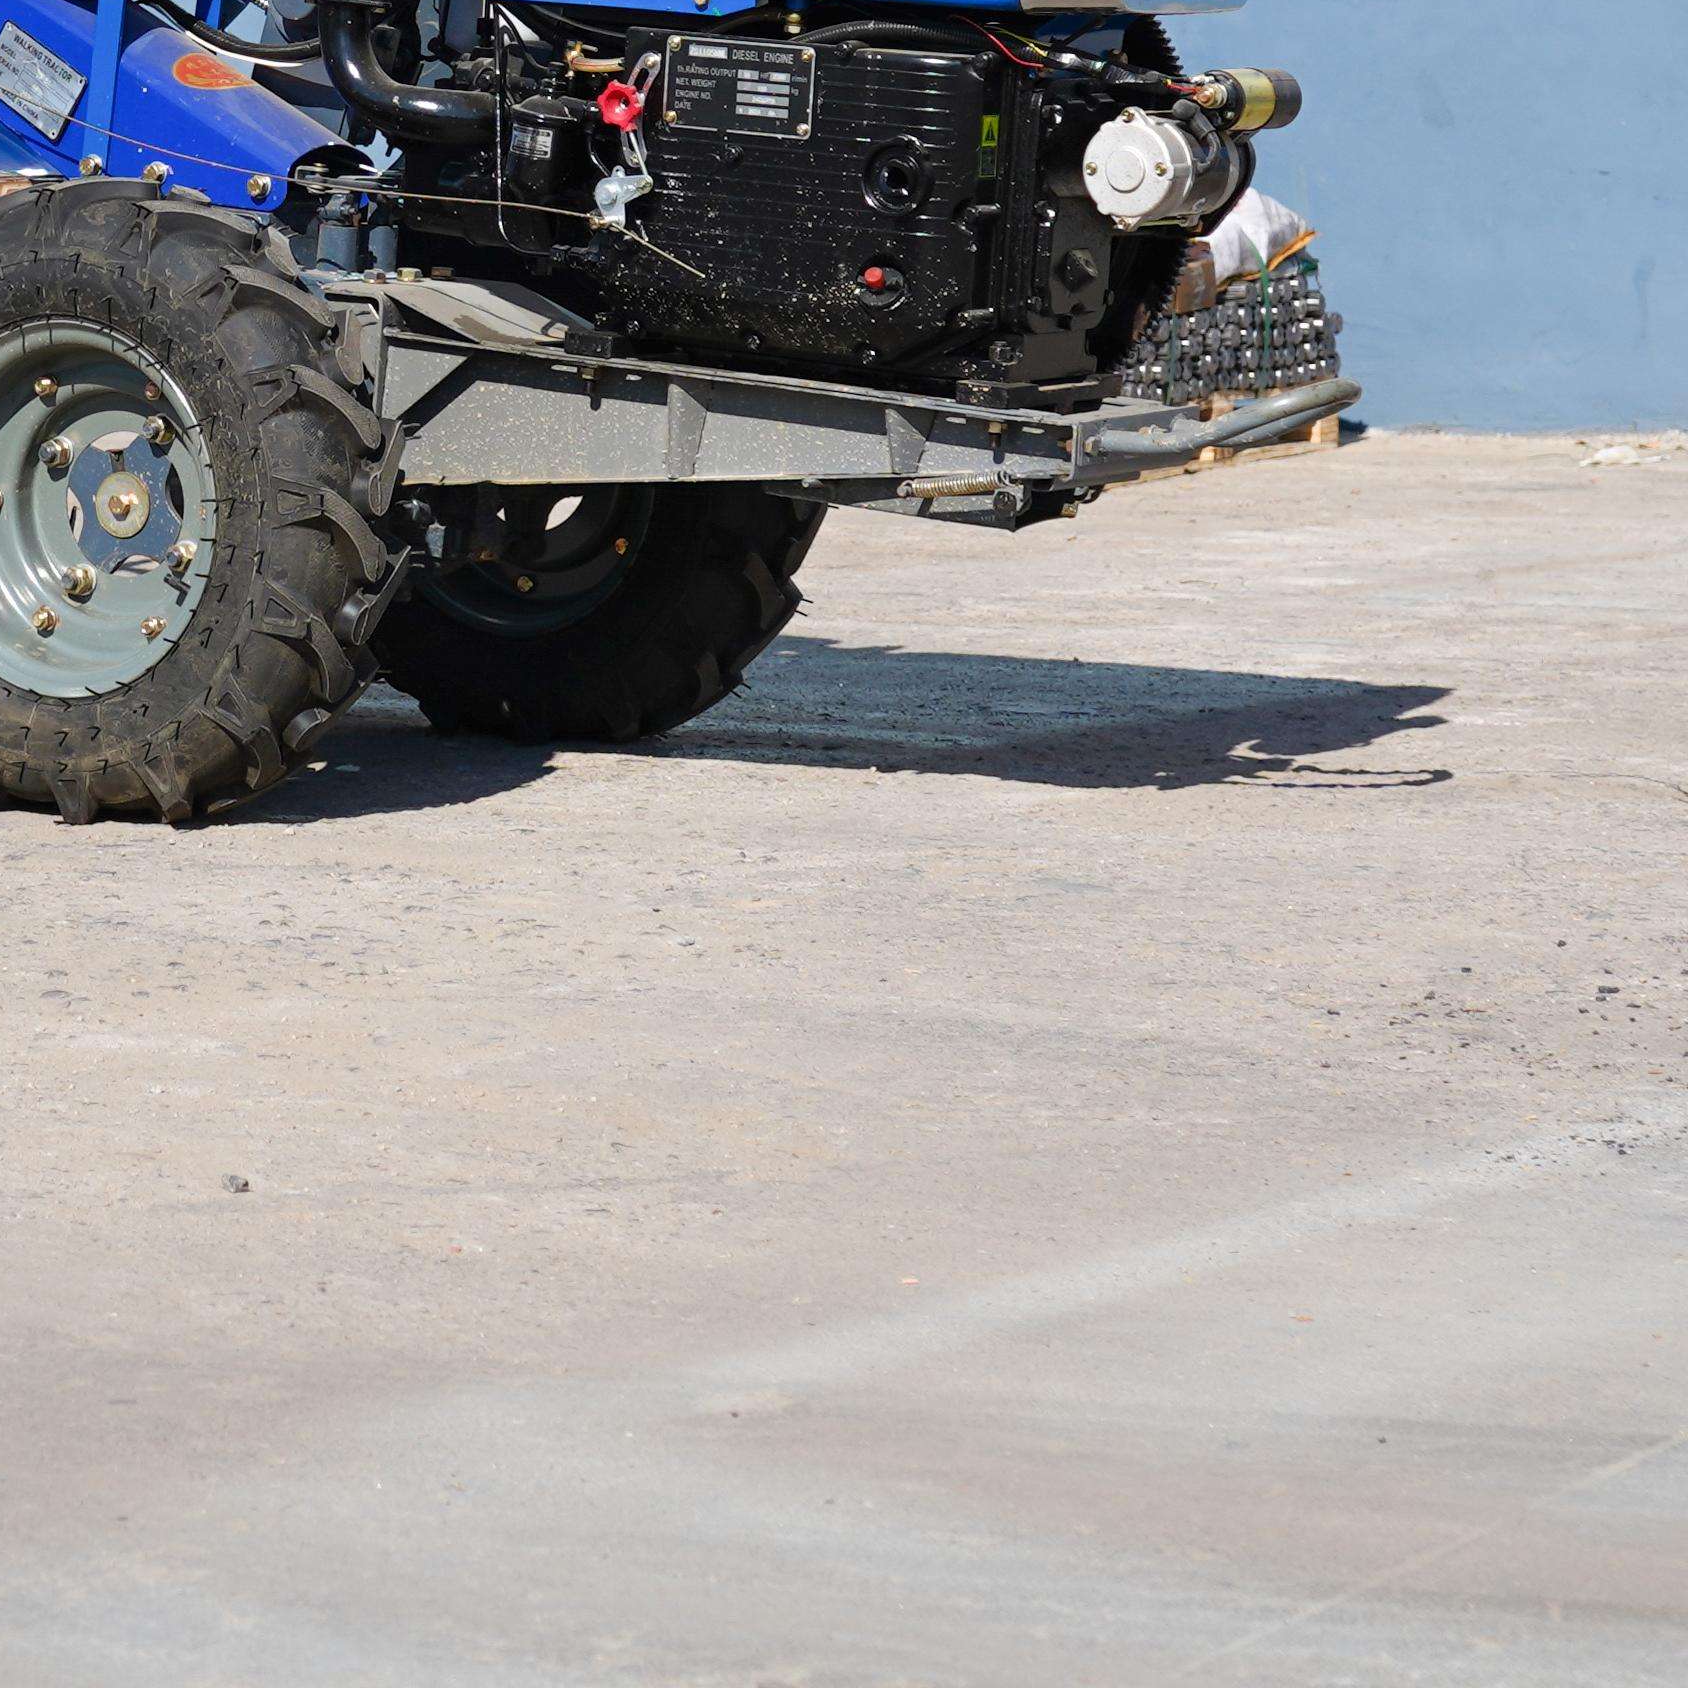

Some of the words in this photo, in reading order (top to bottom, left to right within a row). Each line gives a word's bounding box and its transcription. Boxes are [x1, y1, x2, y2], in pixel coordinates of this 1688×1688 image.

[13, 33, 43, 61] WALKING
[42, 54, 73, 83] TRACTOR
[732, 49, 760, 62] DIESEL
[764, 52, 794, 65] ENGINE
[710, 68, 736, 78] OUTPUT
[674, 100, 692, 111] DATE
